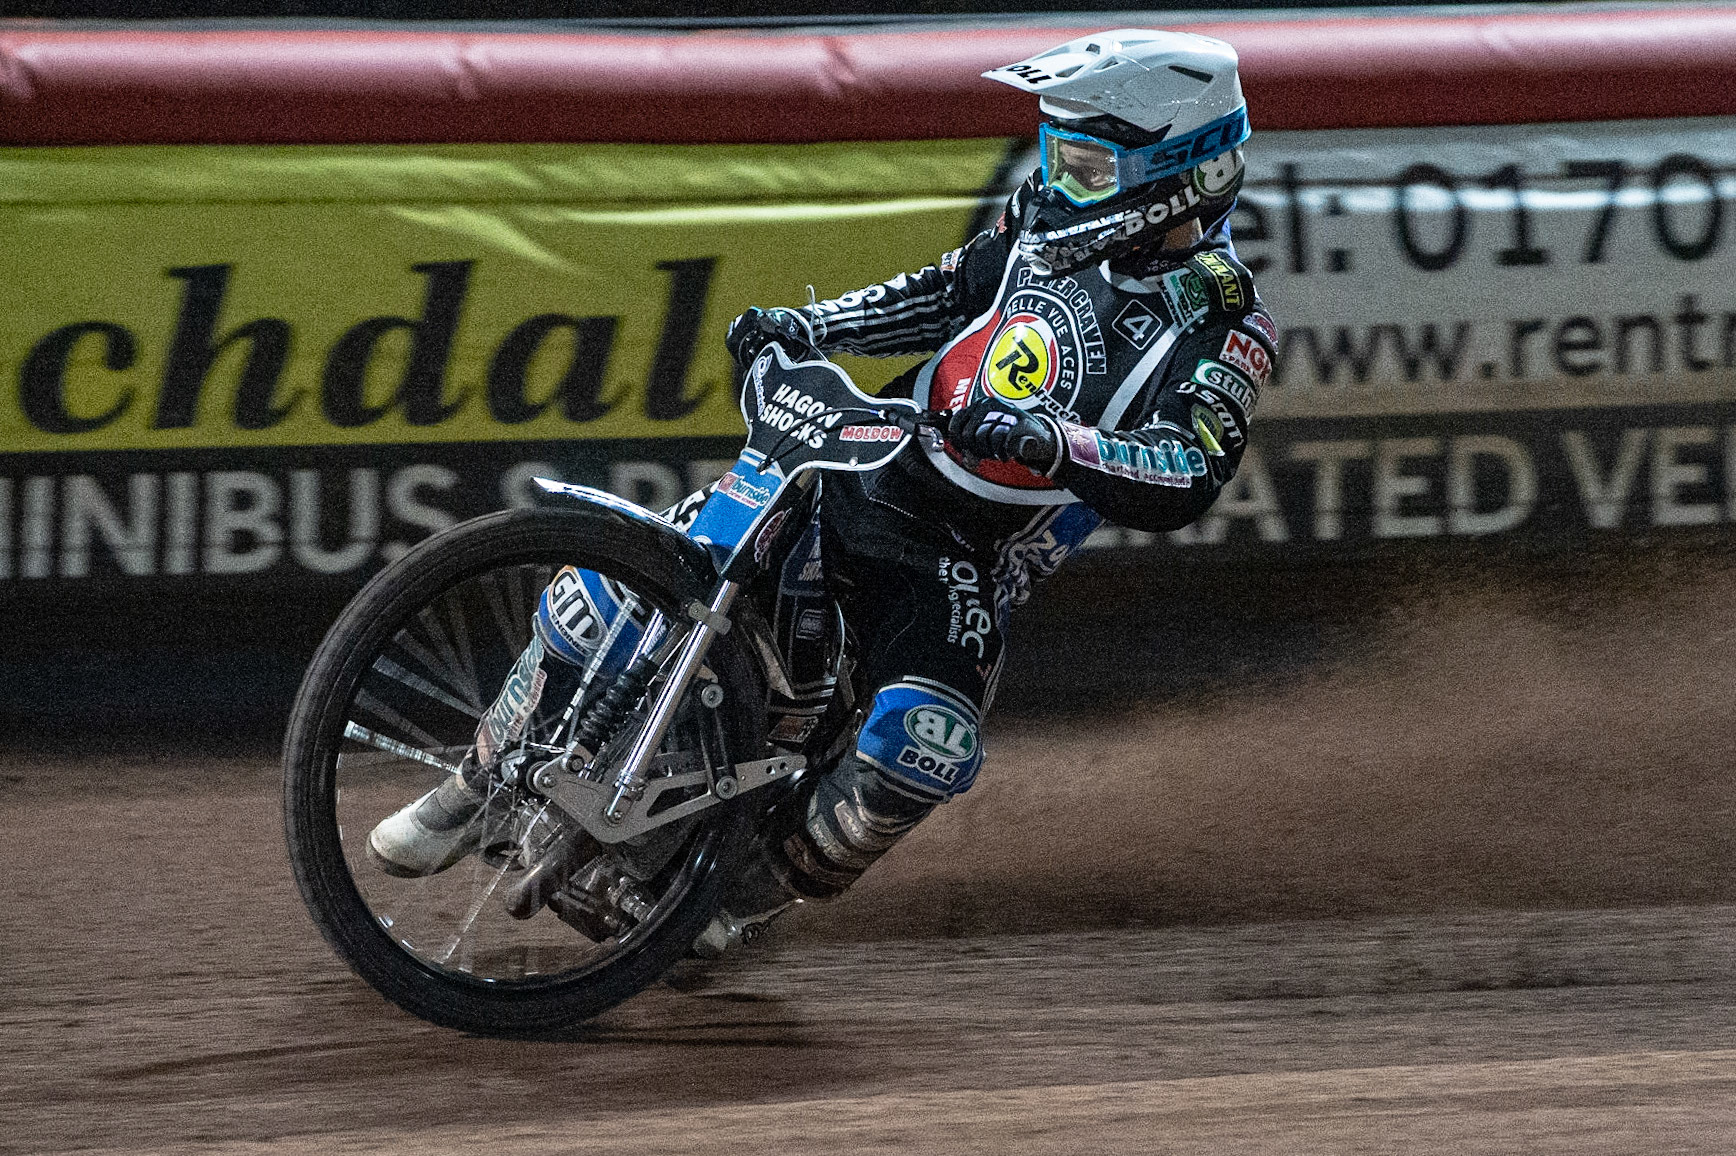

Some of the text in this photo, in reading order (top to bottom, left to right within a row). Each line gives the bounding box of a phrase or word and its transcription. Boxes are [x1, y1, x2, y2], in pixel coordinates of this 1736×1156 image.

[1006, 65, 1052, 84] OLL
[1126, 183, 1200, 236] BOLL
[1398, 152, 1722, 271] 0170
[17, 256, 746, 434] chdal
[1049, 307, 1068, 339] VUE
[1060, 345, 1075, 390] ACES
[1069, 290, 1107, 375] CRAVEN
[1122, 314, 1154, 342] 4
[1268, 295, 1736, 386] ww.rent
[772, 383, 843, 428] HAGON
[841, 426, 903, 440] MOLDOW
[1195, 390, 1245, 448] SCOT
[1095, 432, 1205, 476] burnside
[1083, 424, 1736, 547] ATED VE
[901, 749, 956, 782] BOLL
